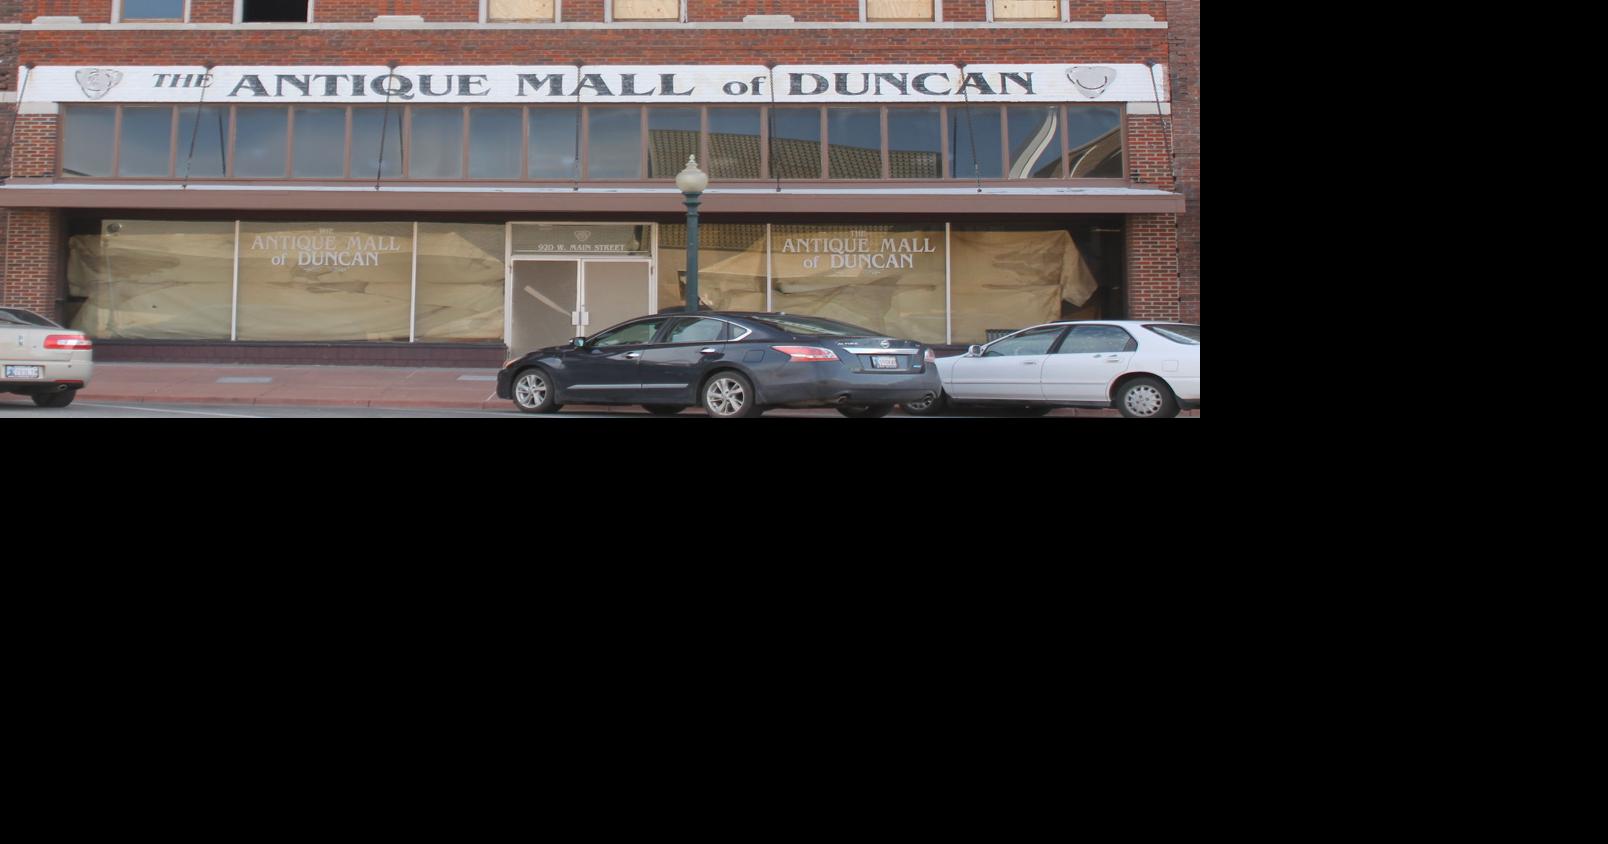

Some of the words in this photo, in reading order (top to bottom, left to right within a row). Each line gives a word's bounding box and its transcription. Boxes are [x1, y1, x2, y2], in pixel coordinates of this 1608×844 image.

[152, 73, 214, 88] THE
[227, 73, 492, 100] ANTIQUE
[516, 73, 696, 97] MALL
[722, 75, 767, 97] of
[787, 71, 1038, 96] DUNCAN
[251, 235, 337, 252] ANTIQUE
[345, 235, 401, 251] MALL
[537, 243, 554, 252] 920
[594, 243, 625, 252] STREET
[782, 238, 870, 254] ANTIQUE
[881, 238, 937, 253] MALL
[271, 252, 289, 266] of
[298, 251, 380, 267] DUNCAN
[803, 255, 820, 269] of
[831, 254, 914, 269] DUNCAN
